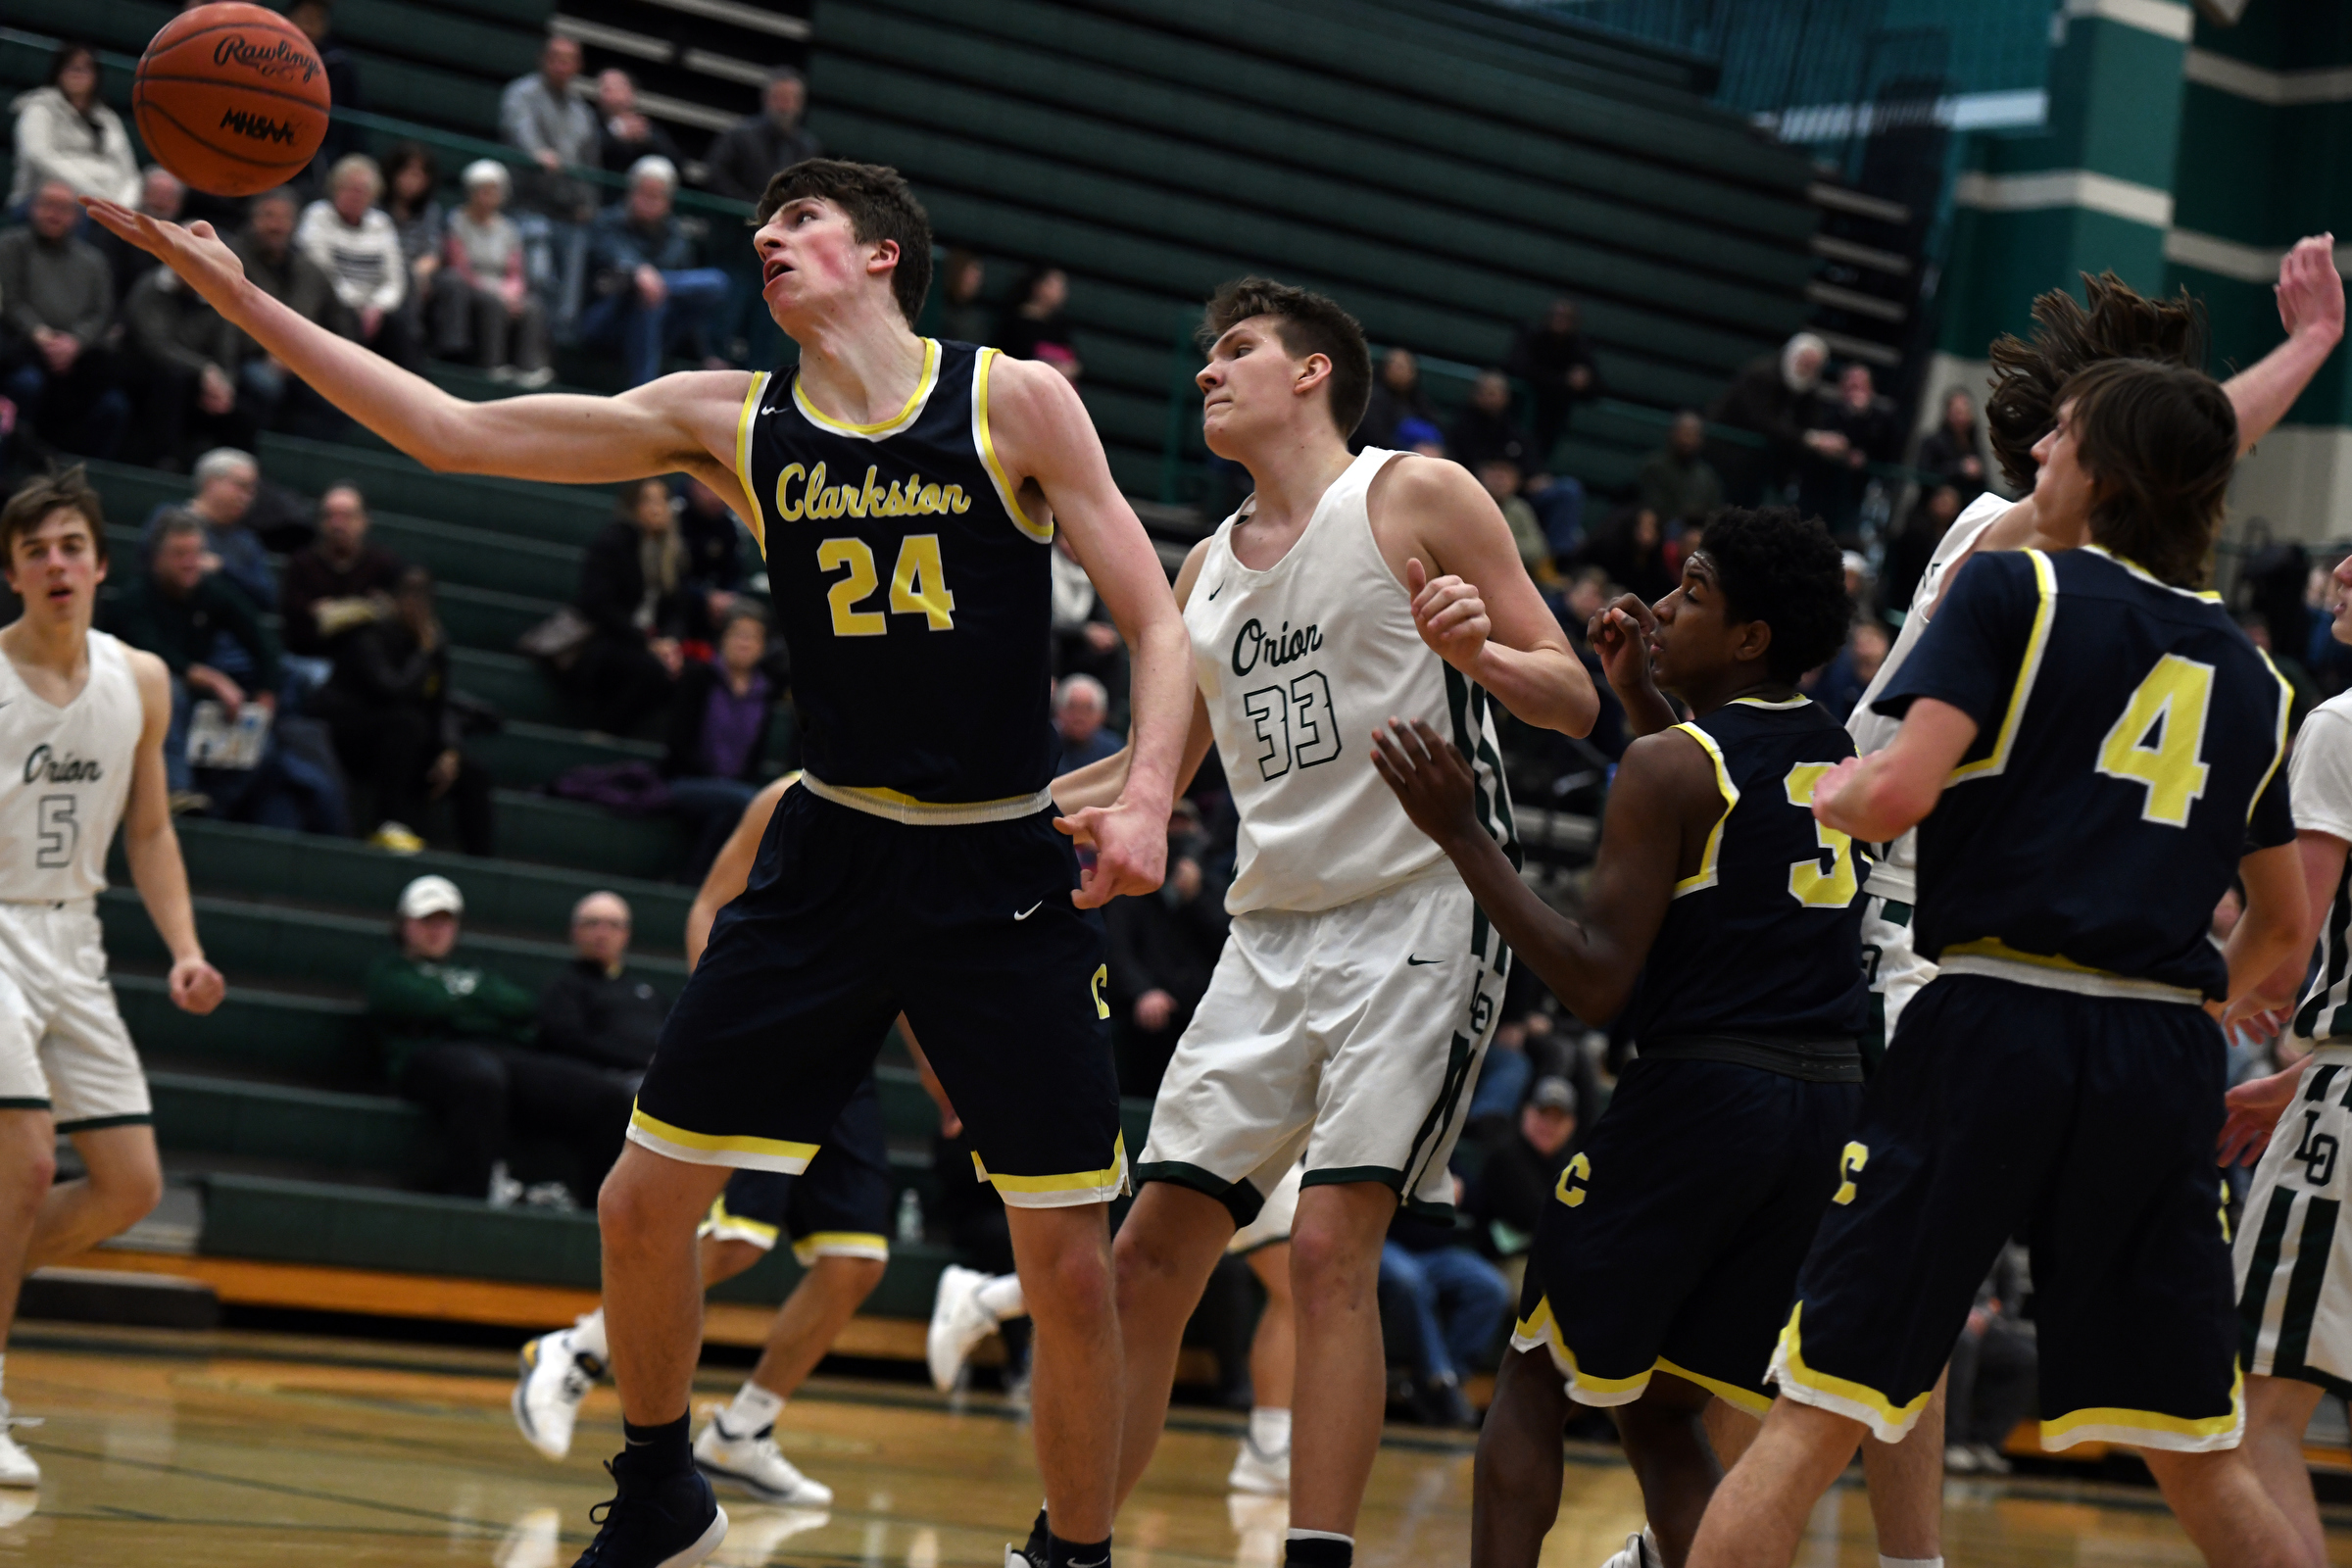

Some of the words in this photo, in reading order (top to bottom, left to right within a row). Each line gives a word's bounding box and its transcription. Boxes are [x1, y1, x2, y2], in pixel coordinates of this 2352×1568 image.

[776, 461, 971, 522] Clarkston
[816, 533, 956, 637] 24
[1232, 617, 1323, 677] Orion
[1244, 669, 1343, 782] 33
[2094, 652, 2216, 829] 4
[24, 743, 103, 785] Orion
[36, 794, 80, 869] 5
[1783, 761, 1858, 908] 3
[1091, 962, 1110, 1020] C
[1555, 1152, 1592, 1207] C
[2294, 1109, 2339, 1187] LO
